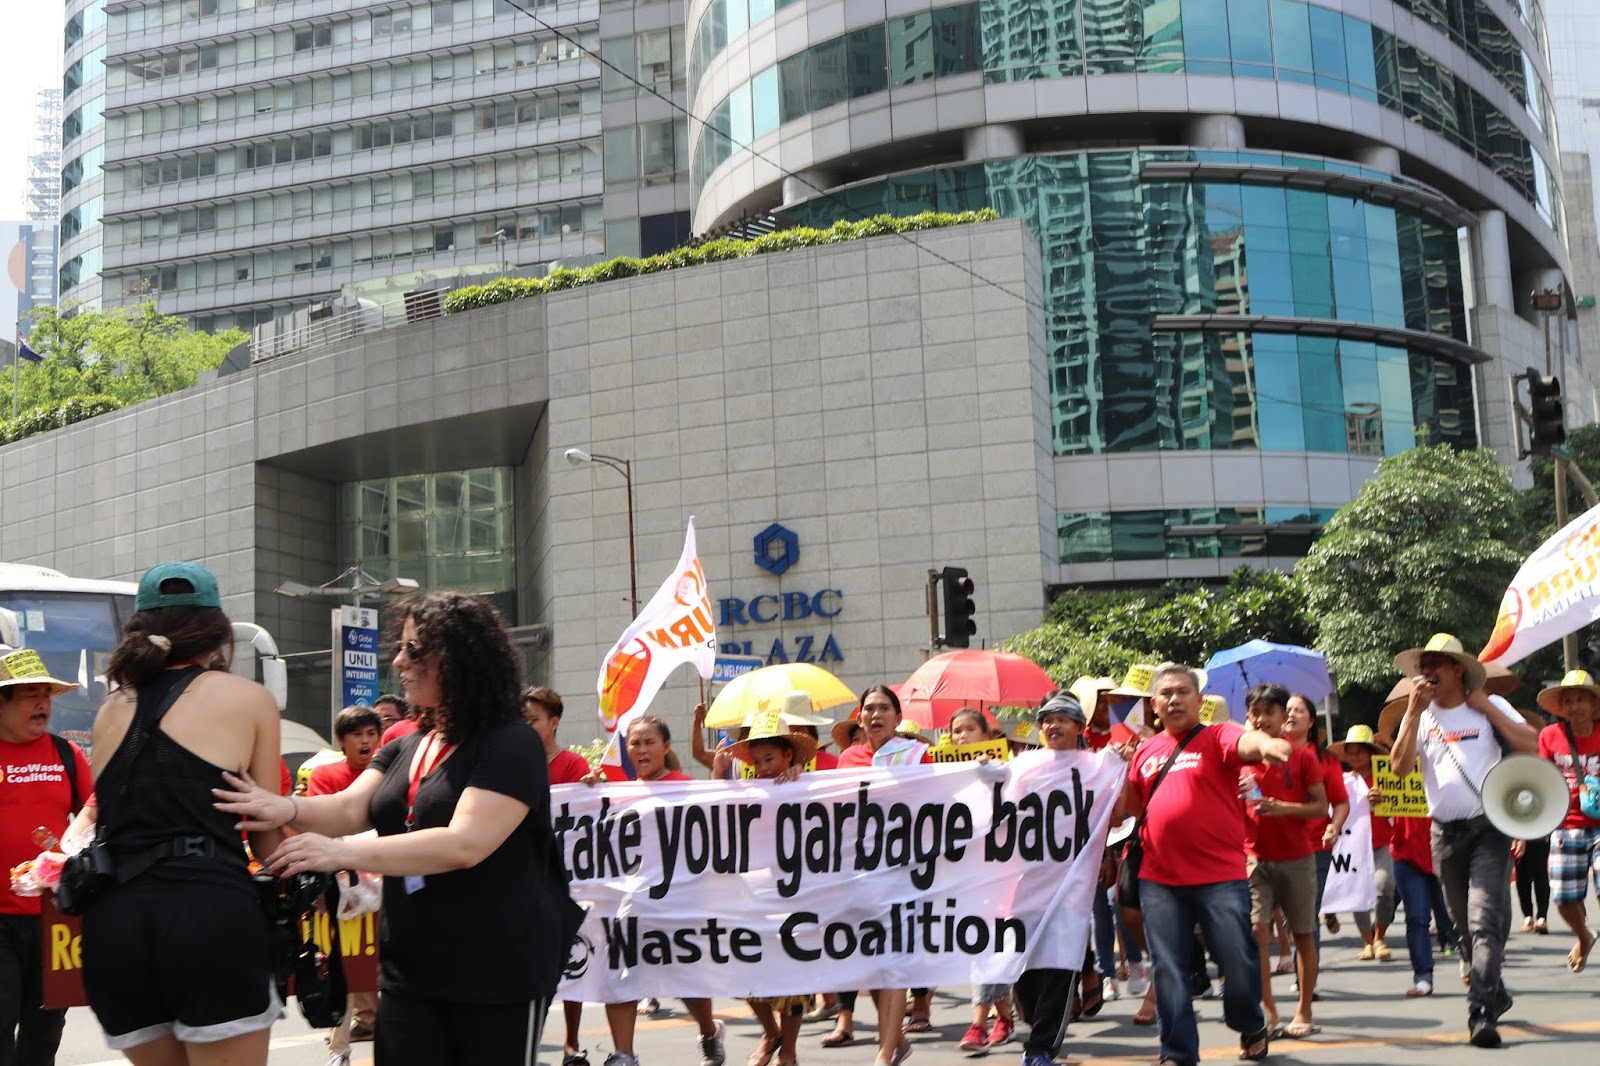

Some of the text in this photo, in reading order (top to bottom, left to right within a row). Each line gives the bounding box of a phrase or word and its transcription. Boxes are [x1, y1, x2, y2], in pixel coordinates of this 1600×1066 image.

[717, 589, 843, 627] RCBC
[348, 652, 373, 667] UNLI
[346, 669, 376, 681] INTERNET
[350, 688, 372, 697] MAKATI
[6, 763, 65, 774] EcoWaste
[7, 773, 62, 783] Coalition
[1377, 776, 1406, 791] Hindi
[556, 767, 1094, 899] take your garbage back
[601, 899, 1027, 970] Waste Coalition
